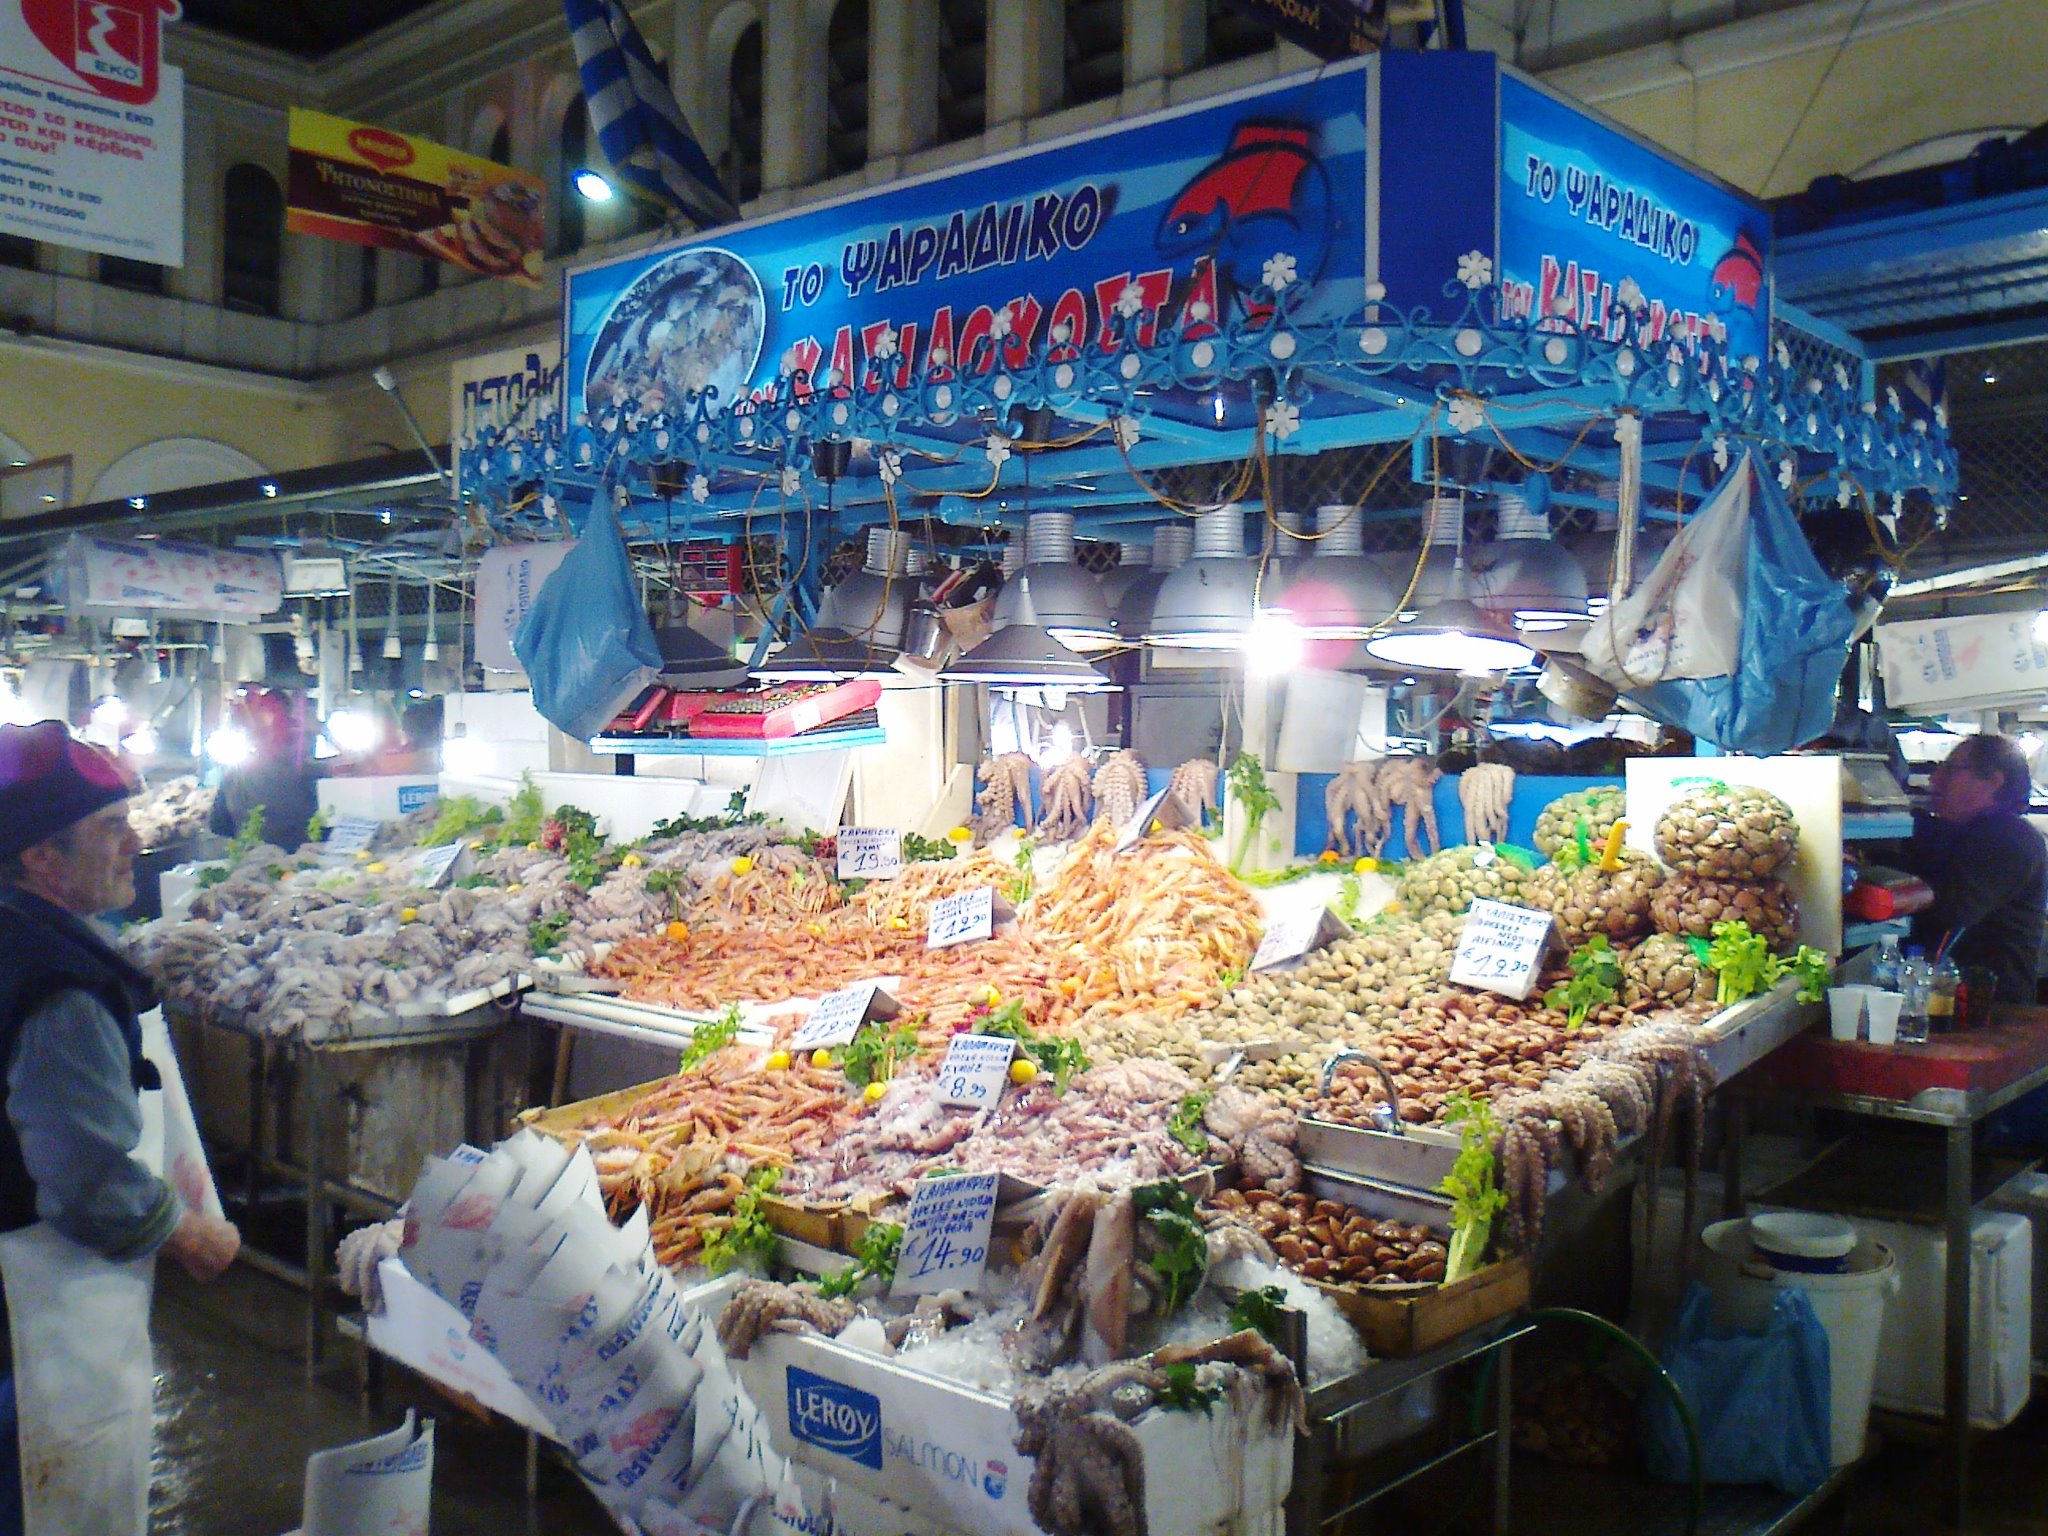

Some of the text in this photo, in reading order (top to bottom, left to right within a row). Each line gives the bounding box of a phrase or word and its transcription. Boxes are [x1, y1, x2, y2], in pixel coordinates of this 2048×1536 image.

[781, 183, 1101, 312] ΤΟ ΨΑΡΑΔΙΚΟ
[1526, 153, 1697, 267] ΤΟ ΨΑΡΑΔΙΚΟ
[795, 1386, 873, 1441] LERØY
